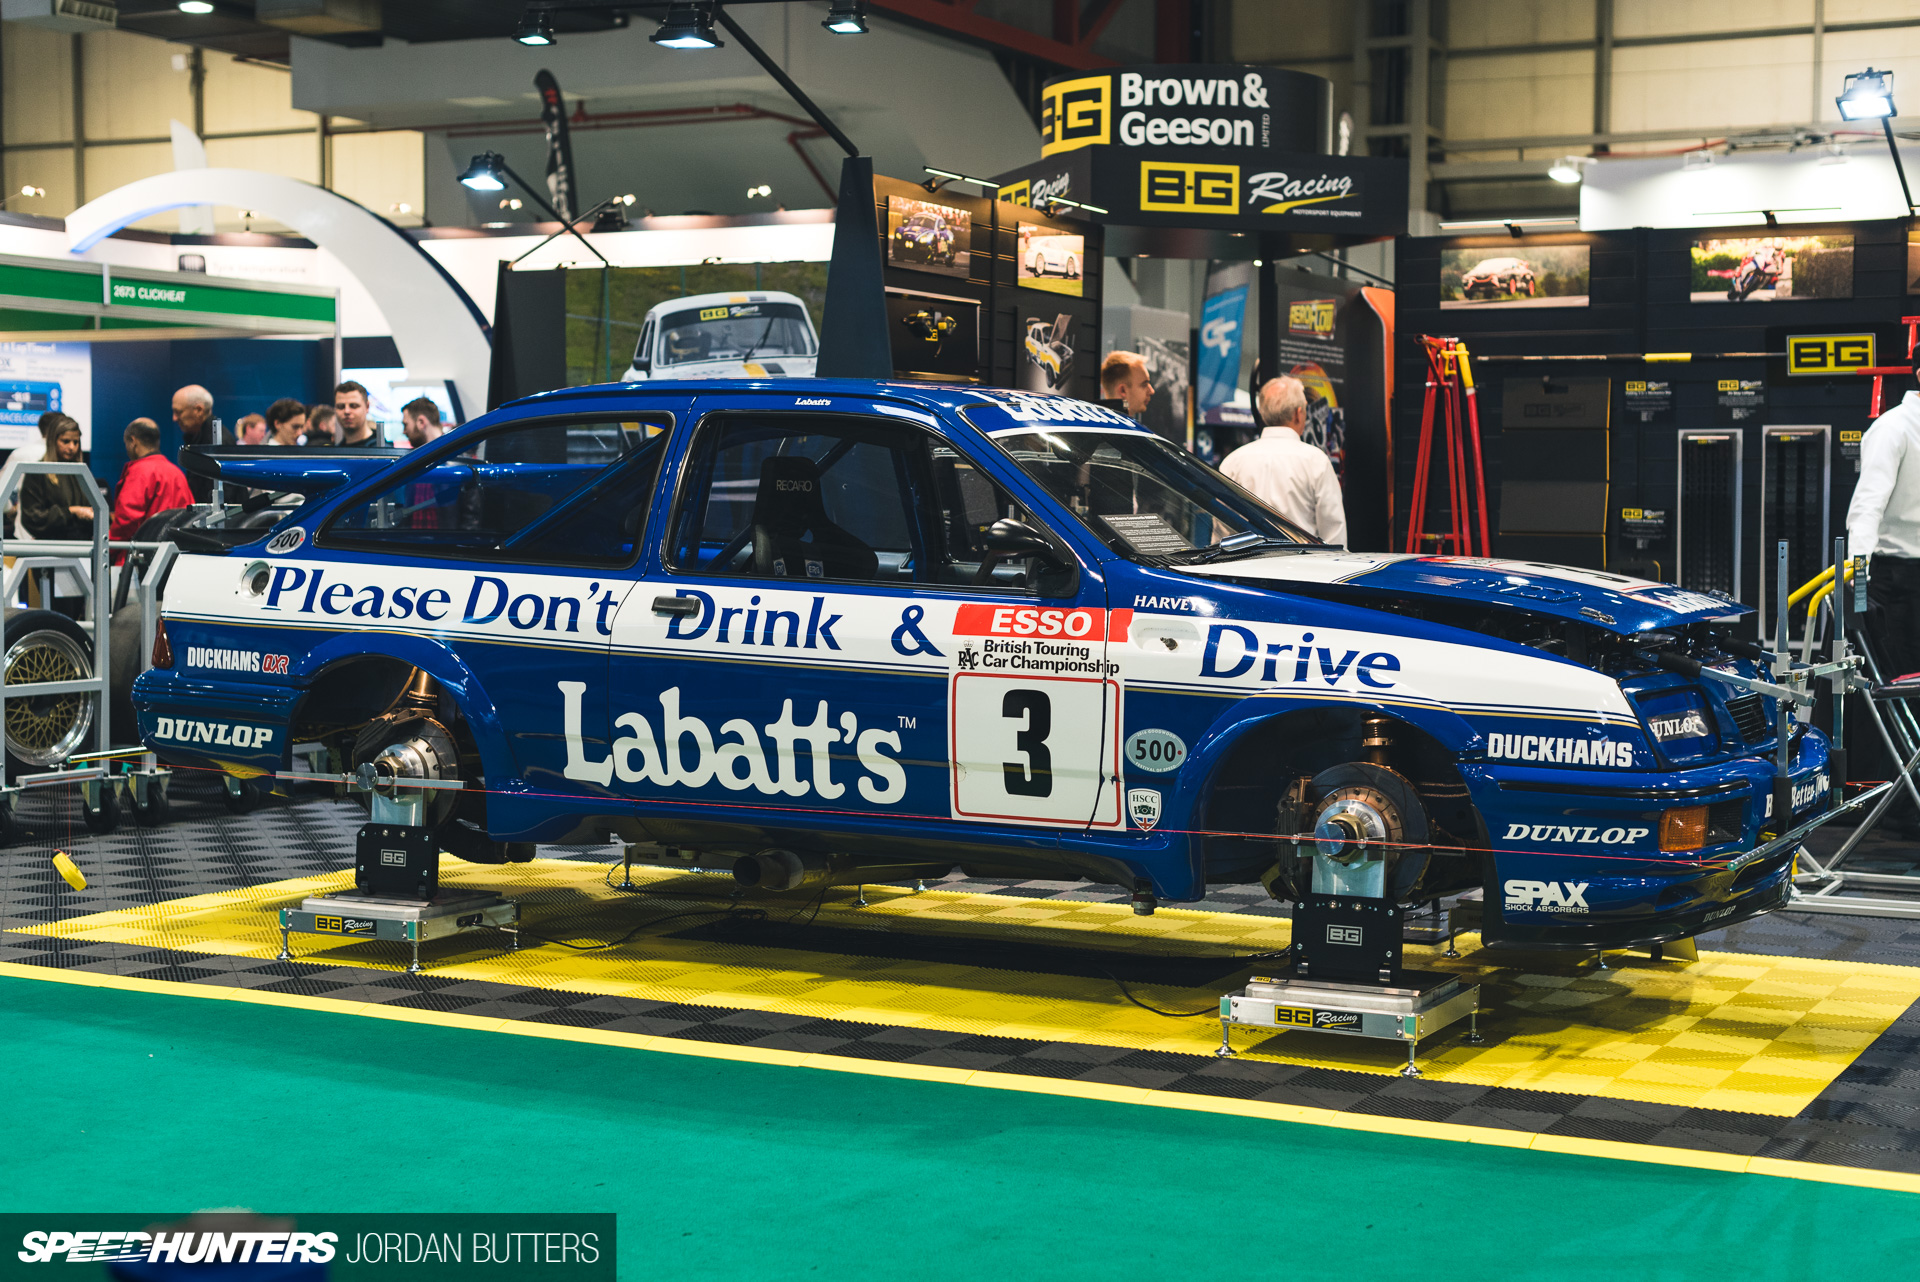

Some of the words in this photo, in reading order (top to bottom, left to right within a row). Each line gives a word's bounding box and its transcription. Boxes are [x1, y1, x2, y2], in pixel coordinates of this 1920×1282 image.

[1119, 110, 1254, 147] Geeson
[1261, 113, 1271, 148] LIMITED
[1247, 171, 1353, 204] Racing
[113, 285, 136, 299] 2673
[138, 287, 186, 303] CLICKHEAT
[795, 397, 832, 406] Labatt's
[776, 480, 813, 492] RECARO
[270, 531, 300, 549] 500
[263, 566, 451, 622] Please
[462, 574, 620, 637] Don't
[666, 588, 843, 651] Drink
[890, 604, 945, 657] &
[1199, 622, 1402, 688] Drive
[990, 608, 1093, 637] ESSO
[187, 646, 260, 673] DUCKHAMS
[983, 639, 1032, 655] British
[1033, 641, 1090, 660] Touring
[982, 653, 1009, 668] Car
[1010, 655, 1120, 677] Championship
[155, 716, 273, 749] DUNLOP
[557, 680, 907, 805] Labatt's
[1001, 688, 1053, 798] 3
[1147, 728, 1177, 740] GOODWOOD
[1135, 738, 1177, 762] 500
[1487, 732, 1634, 768] DUCKHAMS
[1135, 761, 1155, 773] FESTIVAL
[1162, 764, 1177, 773] SPEED
[1132, 794, 1158, 804] HSCC
[1502, 823, 1649, 845] DUNLOP
[1503, 879, 1590, 908] SPAX
[1504, 903, 1533, 912] SHOCK
[1535, 905, 1590, 914] ABSORBERS
[1702, 904, 1737, 923] DUNLOP
[343, 919, 374, 930] Racing
[1316, 1011, 1358, 1025] Racing
